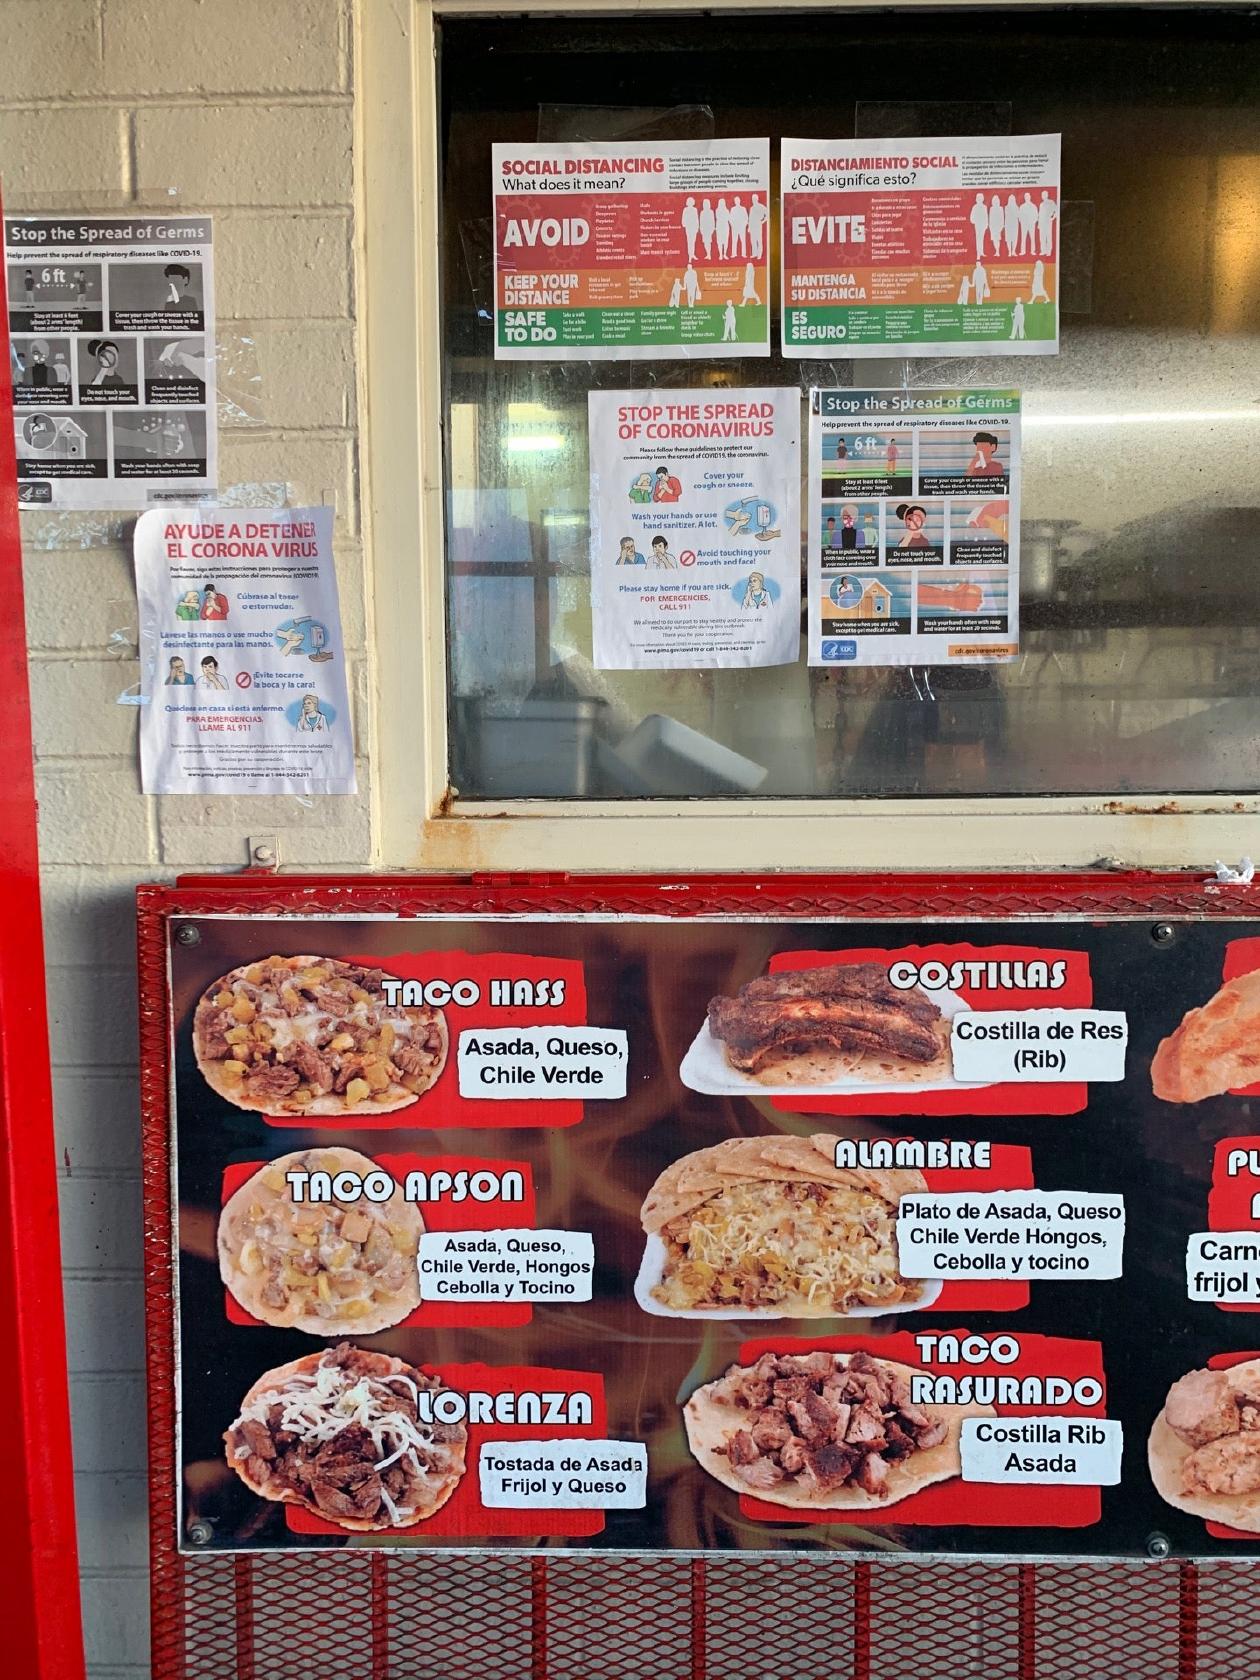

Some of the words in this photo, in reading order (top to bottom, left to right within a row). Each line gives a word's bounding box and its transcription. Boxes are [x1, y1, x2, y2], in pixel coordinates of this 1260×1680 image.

[502, 159, 561, 176] SOCIAL
[565, 158, 664, 174] DISTANCING
[791, 157, 909, 172] DISTANCIAMIENTO
[912, 156, 958, 169] SOCIAL
[503, 178, 537, 191] What
[539, 178, 571, 190] does
[573, 178, 582, 190] it
[584, 177, 626, 190] mean?
[791, 174, 825, 190] ¿Qué
[828, 174, 880, 188] significa
[884, 173, 916, 185] esto?
[12, 227, 46, 242] Stop
[51, 227, 75, 239] the
[80, 226, 132, 242] Spread
[136, 226, 152, 238] of
[156, 226, 204, 239] Germs
[503, 218, 589, 247] AVOID
[792, 215, 865, 244] EVITE
[41, 269, 50, 283] 6
[53, 268, 66, 283] ft
[505, 276, 538, 290] KEEP
[540, 274, 579, 288] YOUR
[791, 274, 856, 287] MANTENGA
[505, 290, 570, 305] DISTANCE
[791, 289, 806, 300] SU
[808, 287, 866, 300] DISTANCIA
[505, 312, 546, 326] SAFE
[792, 312, 808, 324] ES
[505, 328, 528, 341] TO
[531, 327, 557, 341] DO
[792, 325, 847, 339] SEGURO
[618, 405, 662, 422] STOP
[666, 405, 700, 420] THE
[704, 403, 774, 419] SPREAD
[827, 398, 859, 412] Stop
[864, 397, 888, 410] the
[892, 397, 944, 412] Spread
[948, 397, 963, 408] of
[965, 397, 1012, 408] Germs
[618, 424, 641, 440] OF
[646, 422, 774, 439] CORONAVIRUS
[855, 437, 862, 450] 6
[865, 437, 876, 450] ft
[704, 472, 725, 480] Cover
[727, 473, 744, 481] your
[693, 482, 716, 490] cough
[643, 521, 661, 529] hand
[663, 521, 696, 529] sanitizer.
[652, 514, 669, 522] your
[164, 523, 224, 539] AYUDE
[228, 523, 241, 538] A
[246, 522, 316, 538] DETENER
[168, 543, 187, 558] EL
[192, 543, 268, 558] CORONA
[273, 542, 318, 557] VIRUS
[720, 549, 752, 558] touching
[755, 549, 771, 557] your
[888, 960, 1067, 990] COSTILLAS
[381, 979, 480, 1007] TACO
[490, 979, 566, 1007] HASS
[956, 1022, 1040, 1040] Costilla
[1047, 1022, 1074, 1039] de
[1081, 1022, 1123, 1039] Res
[465, 1038, 540, 1058] Asada,
[547, 1038, 623, 1058] Queso,
[1014, 1050, 1066, 1072] (Rib)
[480, 1066, 535, 1084] Chile
[542, 1066, 604, 1084] Verde
[834, 1139, 992, 1170] ALAMBRE
[286, 1170, 395, 1203] TACO
[404, 1170, 525, 1202] APSON
[902, 1202, 951, 1220] Plato
[957, 1203, 980, 1219] de
[986, 1204, 1051, 1222] Asada,
[1057, 1203, 1121, 1220] Queso
[910, 1228, 959, 1244] Chile
[965, 1229, 1019, 1244] Verde
[1026, 1228, 1107, 1248] Hongos,
[444, 1238, 501, 1256] Asada,
[507, 1239, 566, 1256] Queso,
[1200, 1240, 1260, 1260] Carn
[421, 1260, 464, 1274] Chile
[468, 1260, 520, 1275] Verde,
[526, 1260, 590, 1277] Hongos
[934, 1254, 1006, 1270] Cebolla
[1012, 1258, 1023, 1273] y
[1029, 1254, 1089, 1270] tocino
[437, 1280, 499, 1294] Cebolla
[504, 1284, 514, 1297] y
[519, 1280, 575, 1294] Tocino
[1194, 1271, 1248, 1297] frijol
[915, 1335, 1020, 1364] TACO
[911, 1376, 1103, 1405] RASURADO
[417, 1391, 593, 1425] LORENZA
[977, 1424, 1061, 1443] Costilla
[1068, 1425, 1105, 1444] Rib
[485, 1457, 557, 1471] Tostada
[560, 1457, 581, 1471] de
[586, 1458, 642, 1471] Asada
[1005, 1453, 1076, 1472] Asada
[502, 1479, 546, 1495] Frijol
[552, 1482, 563, 1495] y
[568, 1479, 626, 1493] Queso
